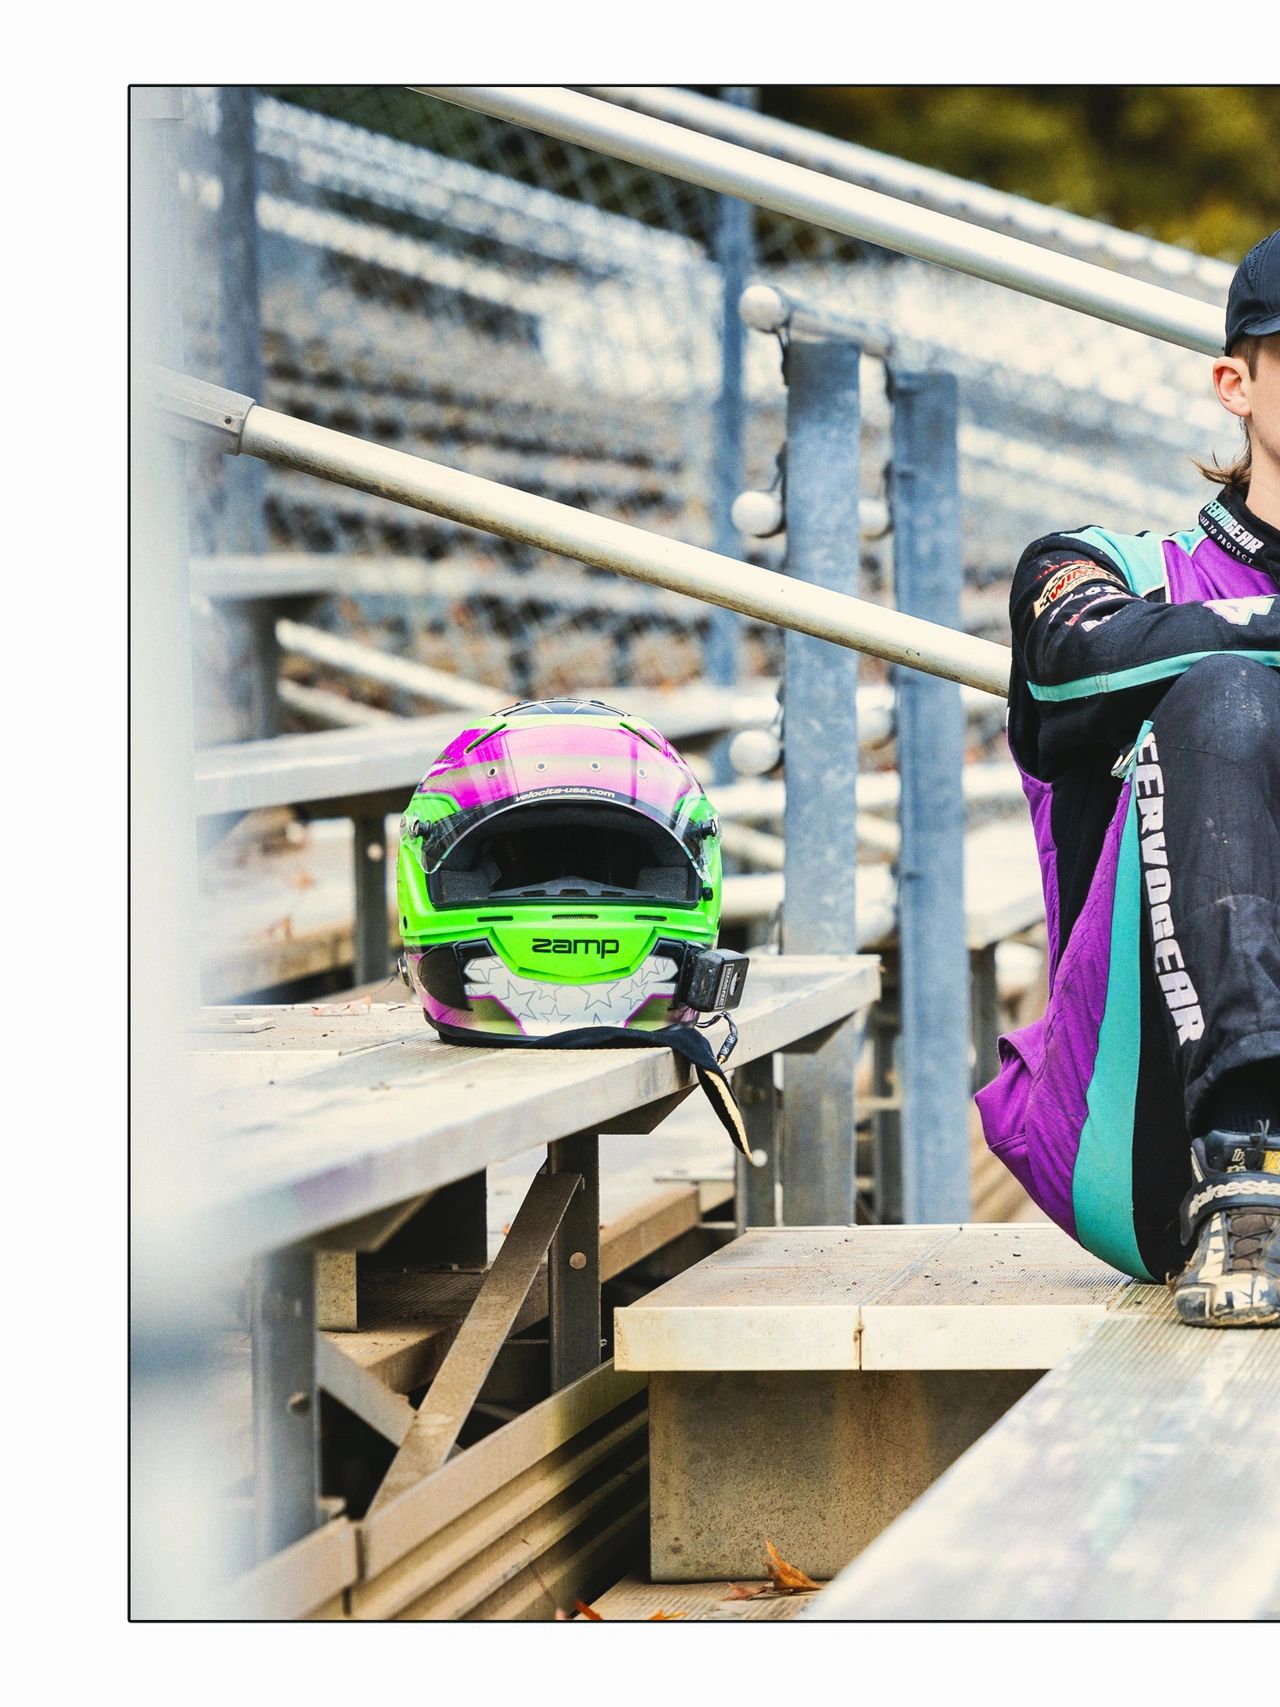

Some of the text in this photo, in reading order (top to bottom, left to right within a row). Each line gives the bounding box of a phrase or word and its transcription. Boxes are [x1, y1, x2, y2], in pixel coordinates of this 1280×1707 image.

[1207, 524, 1253, 564] TO PROTECT
[1136, 732, 1205, 1047] FERVOGEAR
[531, 937, 620, 960] zamp
